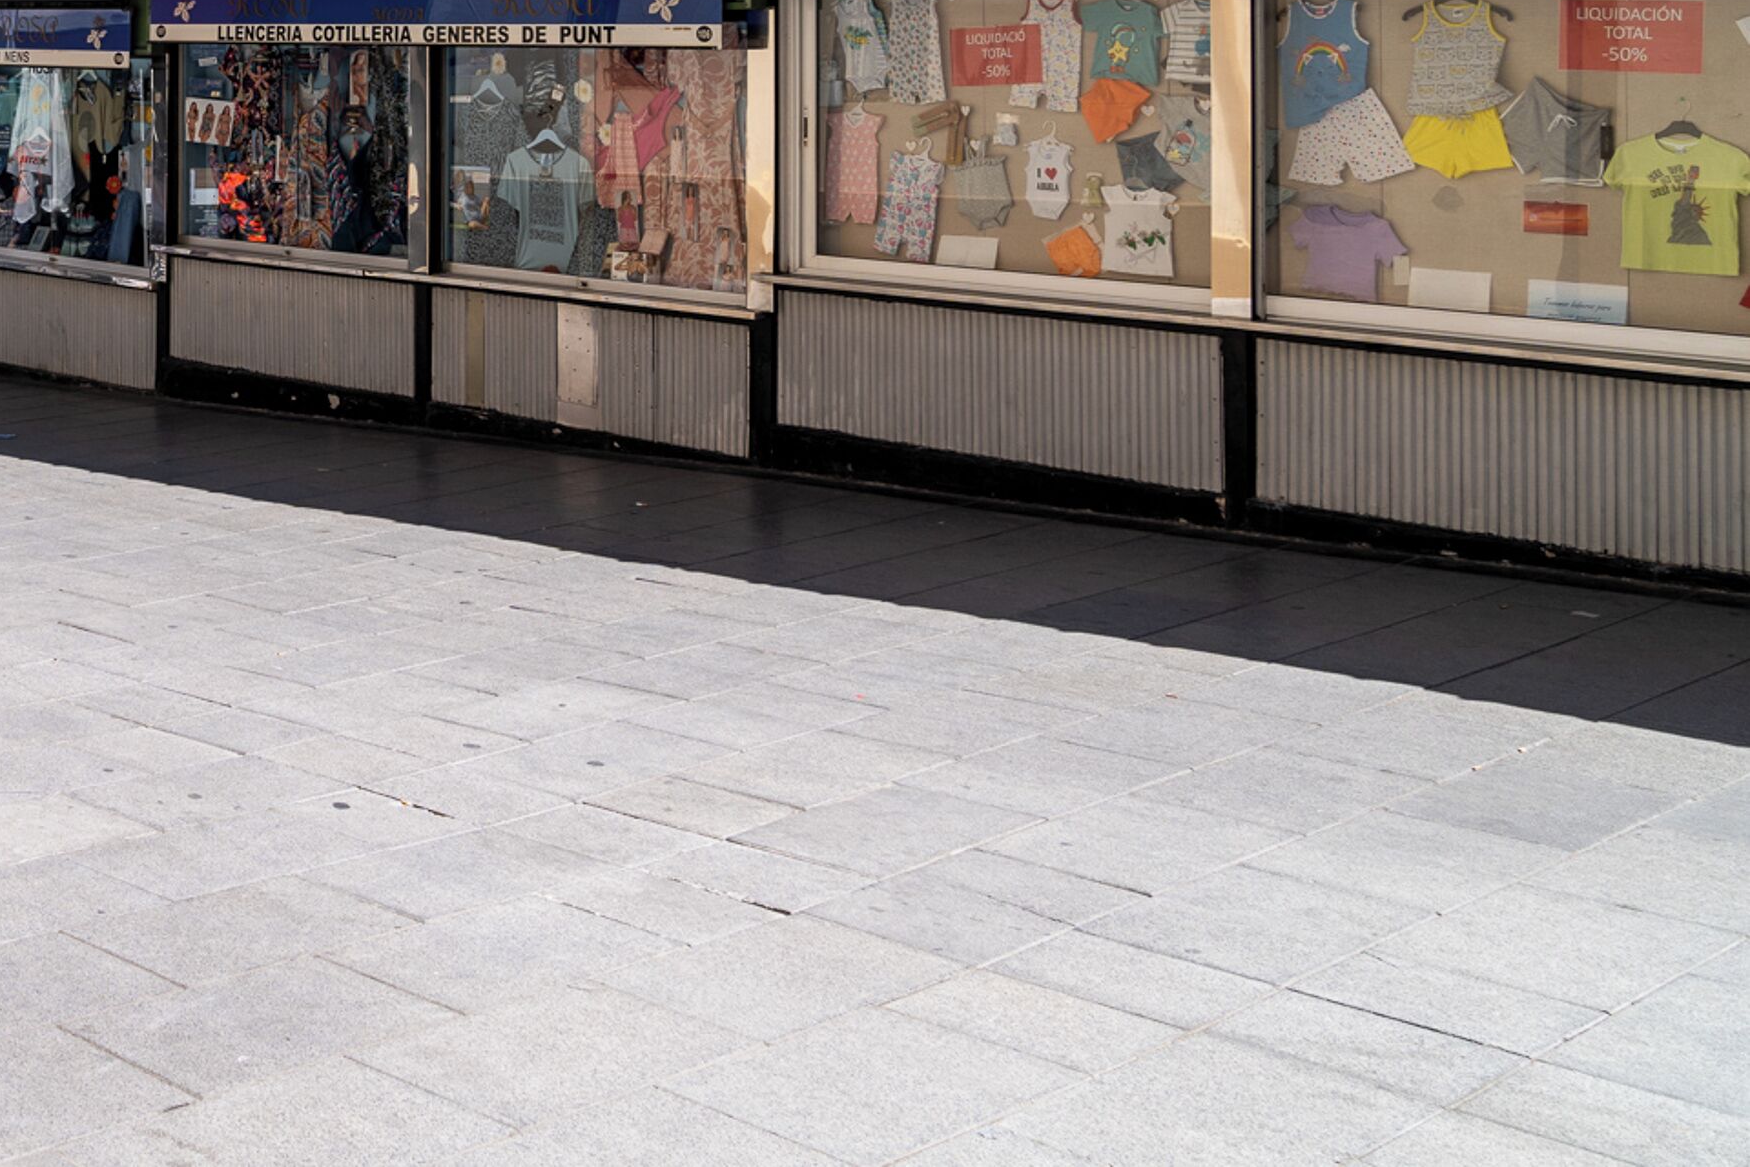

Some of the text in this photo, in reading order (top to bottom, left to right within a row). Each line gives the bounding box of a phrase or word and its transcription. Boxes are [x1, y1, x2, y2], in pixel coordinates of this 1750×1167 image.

[1576, 5, 1683, 22] LIQUIDACIÓN
[217, 25, 616, 44] LLENCERIA COTILLERIA GENERES DE PUNT
[965, 28, 1026, 46] LIQUIDACIÓ
[1603, 26, 1653, 40] TOTAL
[4, 51, 30, 63] NENS
[981, 47, 1013, 60] TOTAL
[1601, 46, 1648, 62] -50%
[981, 64, 1011, 78] -50%
